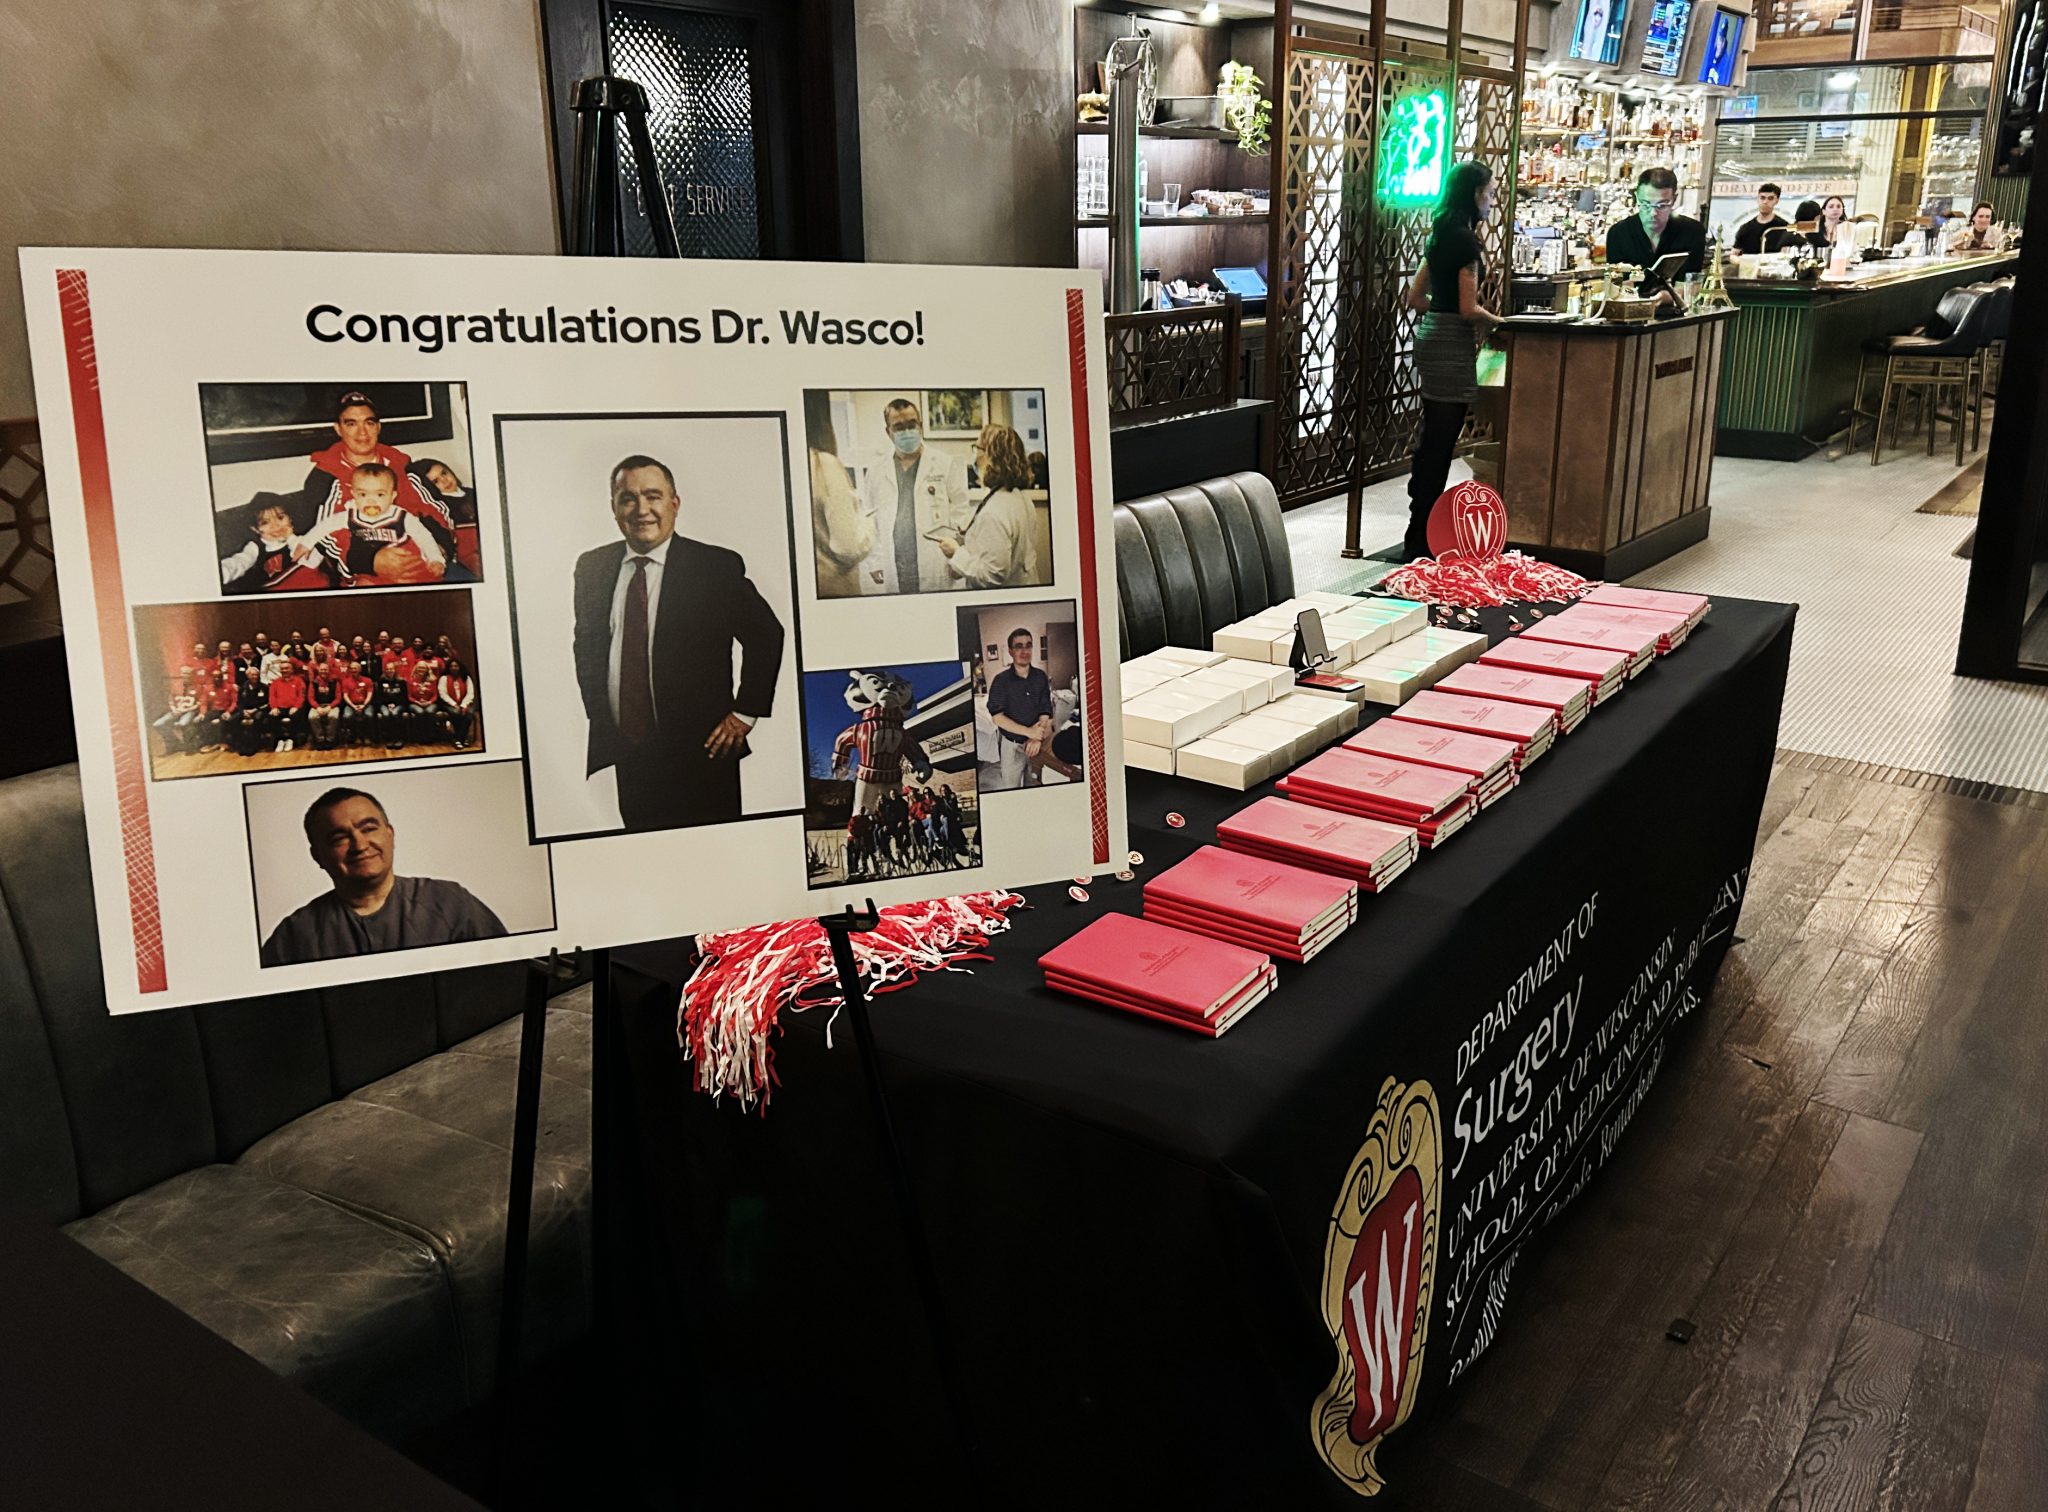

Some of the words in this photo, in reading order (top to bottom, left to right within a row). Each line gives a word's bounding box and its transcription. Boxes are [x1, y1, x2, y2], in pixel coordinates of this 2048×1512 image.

[686, 183, 749, 216] SERVICE
[306, 304, 701, 353] Congratulations
[711, 308, 770, 344] Dr.
[779, 309, 925, 346] Wasco!
[1466, 509, 1493, 552] W
[1452, 975, 1584, 1179] Surgery
[1456, 919, 1575, 1085] DEPARTMENT
[1578, 891, 1599, 939] OF
[1446, 1182, 1528, 1327] SCHOOL
[1534, 1137, 1562, 1192] OF
[1563, 1022, 1641, 1157] MEDICINE
[1642, 979, 1671, 1041] AND
[1448, 1074, 1568, 1259] UNIVERSITY
[1569, 1041, 1593, 1092] OF
[1596, 928, 1676, 1056] WISCONSIN
[1348, 1200, 1418, 1429] W
